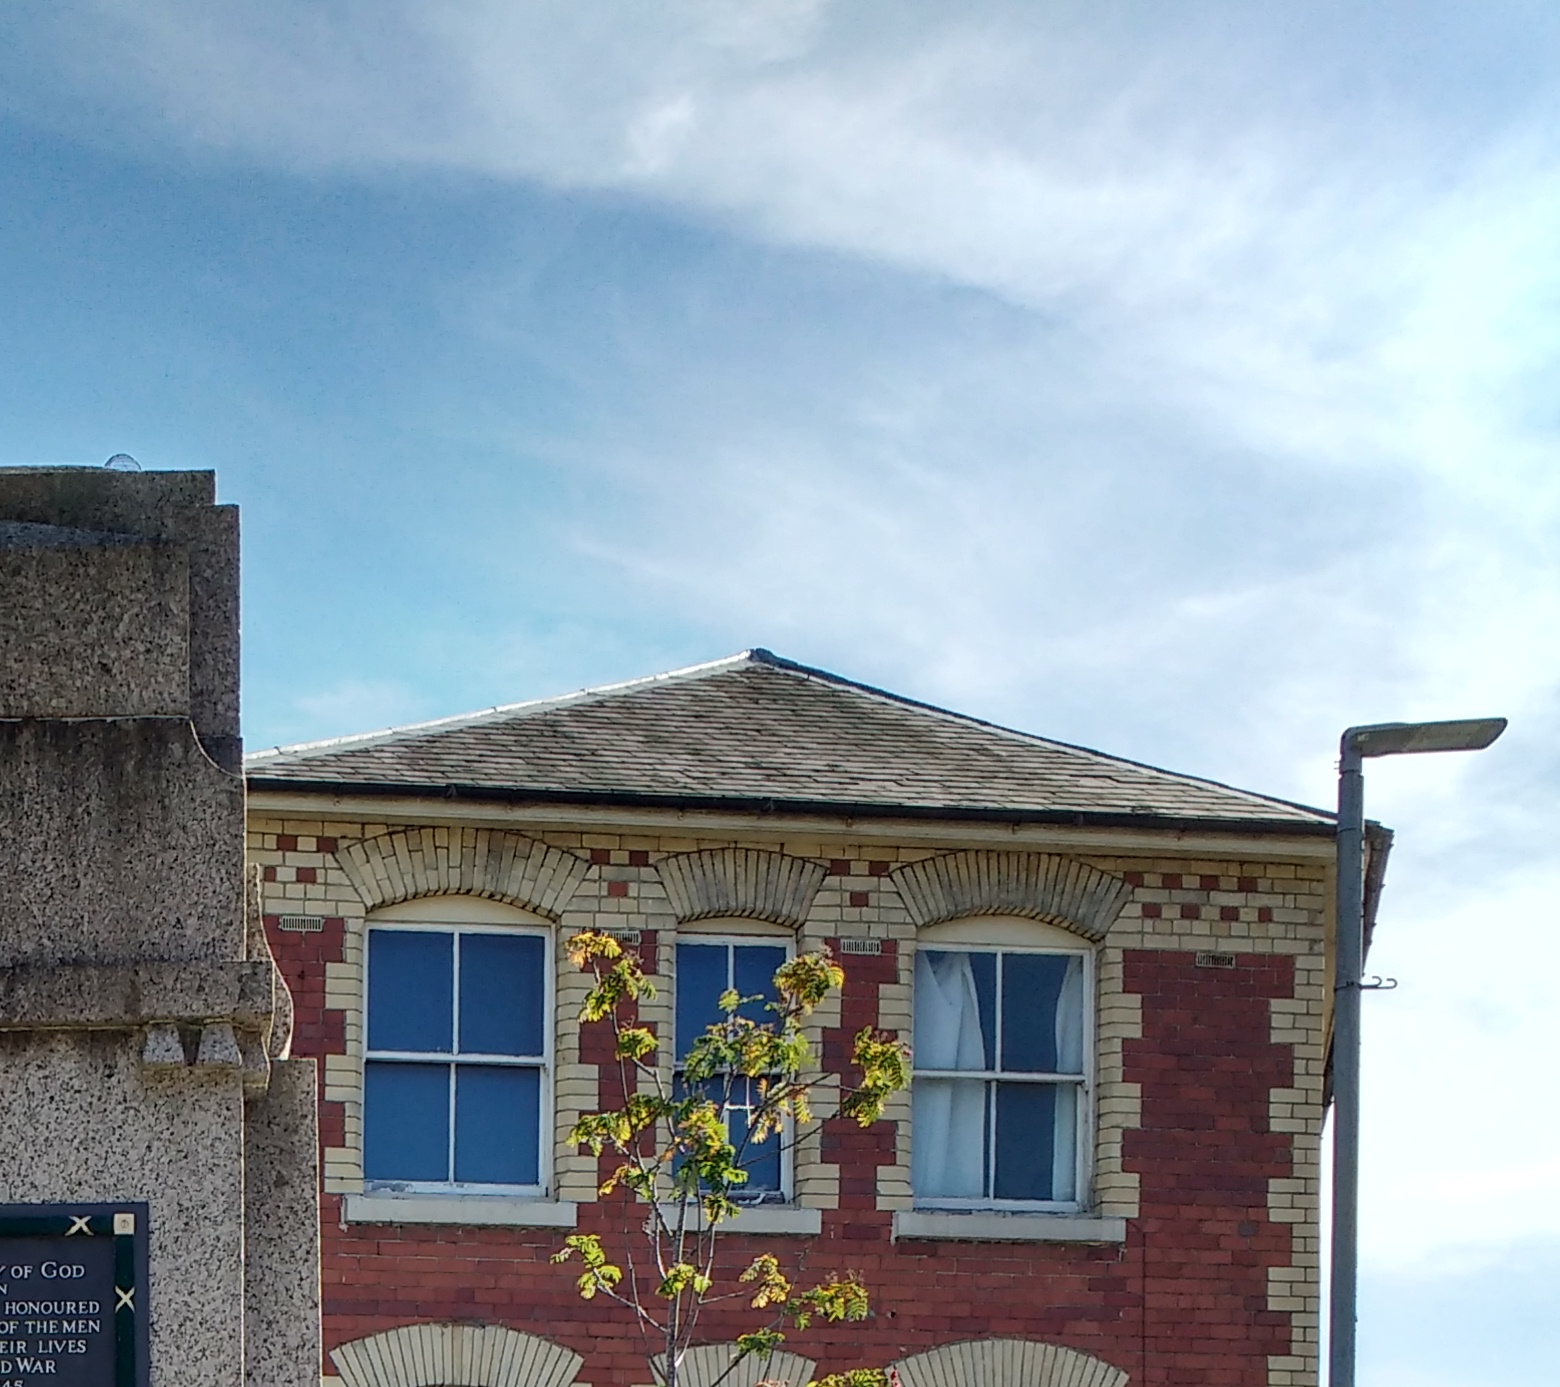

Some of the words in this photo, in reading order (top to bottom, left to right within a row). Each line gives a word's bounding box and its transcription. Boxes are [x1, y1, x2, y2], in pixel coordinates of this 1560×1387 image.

[10, 1265, 33, 1279] OF
[40, 1261, 85, 1279] GOD
[4, 1300, 100, 1315] HONOURED
[24, 1319, 59, 1334] THE
[62, 1319, 101, 1334] MEN
[38, 1339, 87, 1354] LIVES
[15, 1356, 56, 1374] WAR
